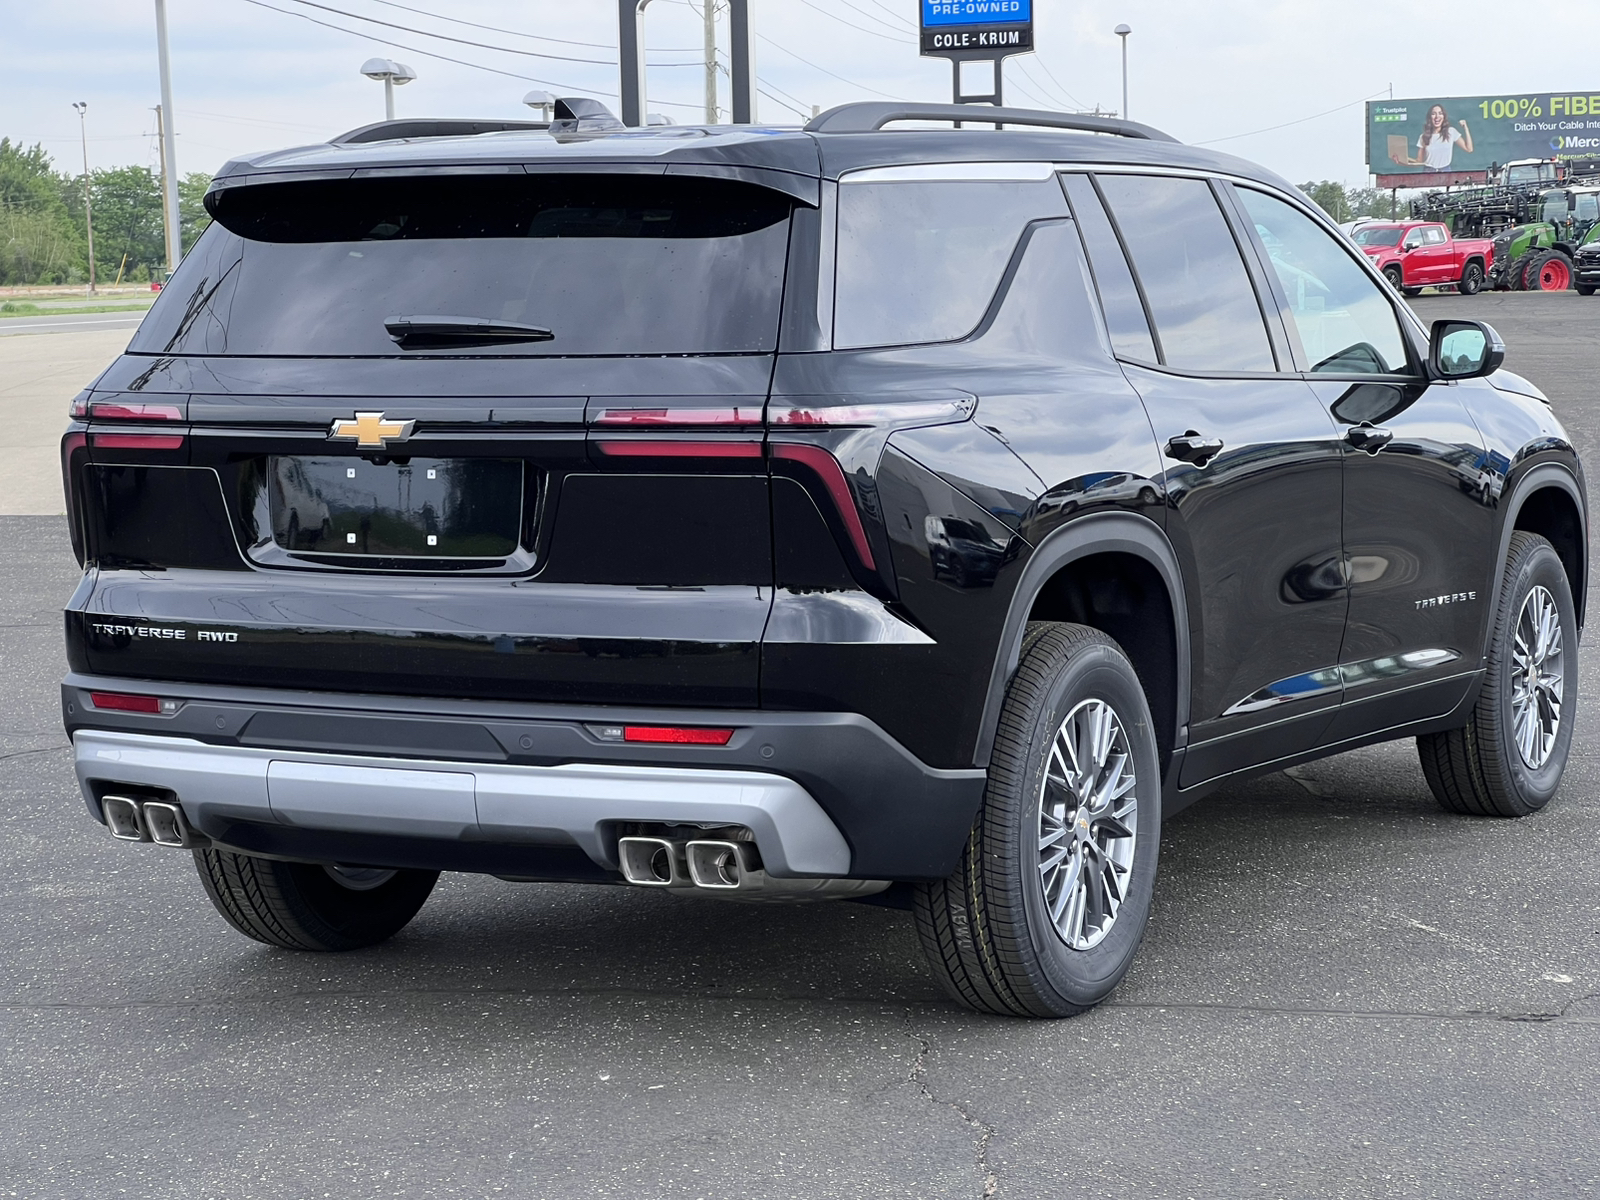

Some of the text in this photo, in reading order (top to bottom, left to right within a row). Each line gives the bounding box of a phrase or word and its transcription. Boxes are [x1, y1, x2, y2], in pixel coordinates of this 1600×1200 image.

[933, 2, 1020, 15] PRE-OWNED
[933, 31, 1019, 47] COLE-KRUM
[1479, 95, 1600, 119] 100% FIBE
[1514, 122, 1536, 131] Ditch
[1538, 122, 1557, 130] Your
[1559, 121, 1584, 130] Cable
[1414, 591, 1477, 610] TRAVERSE
[92, 623, 239, 643] TRAVERSE AWD
